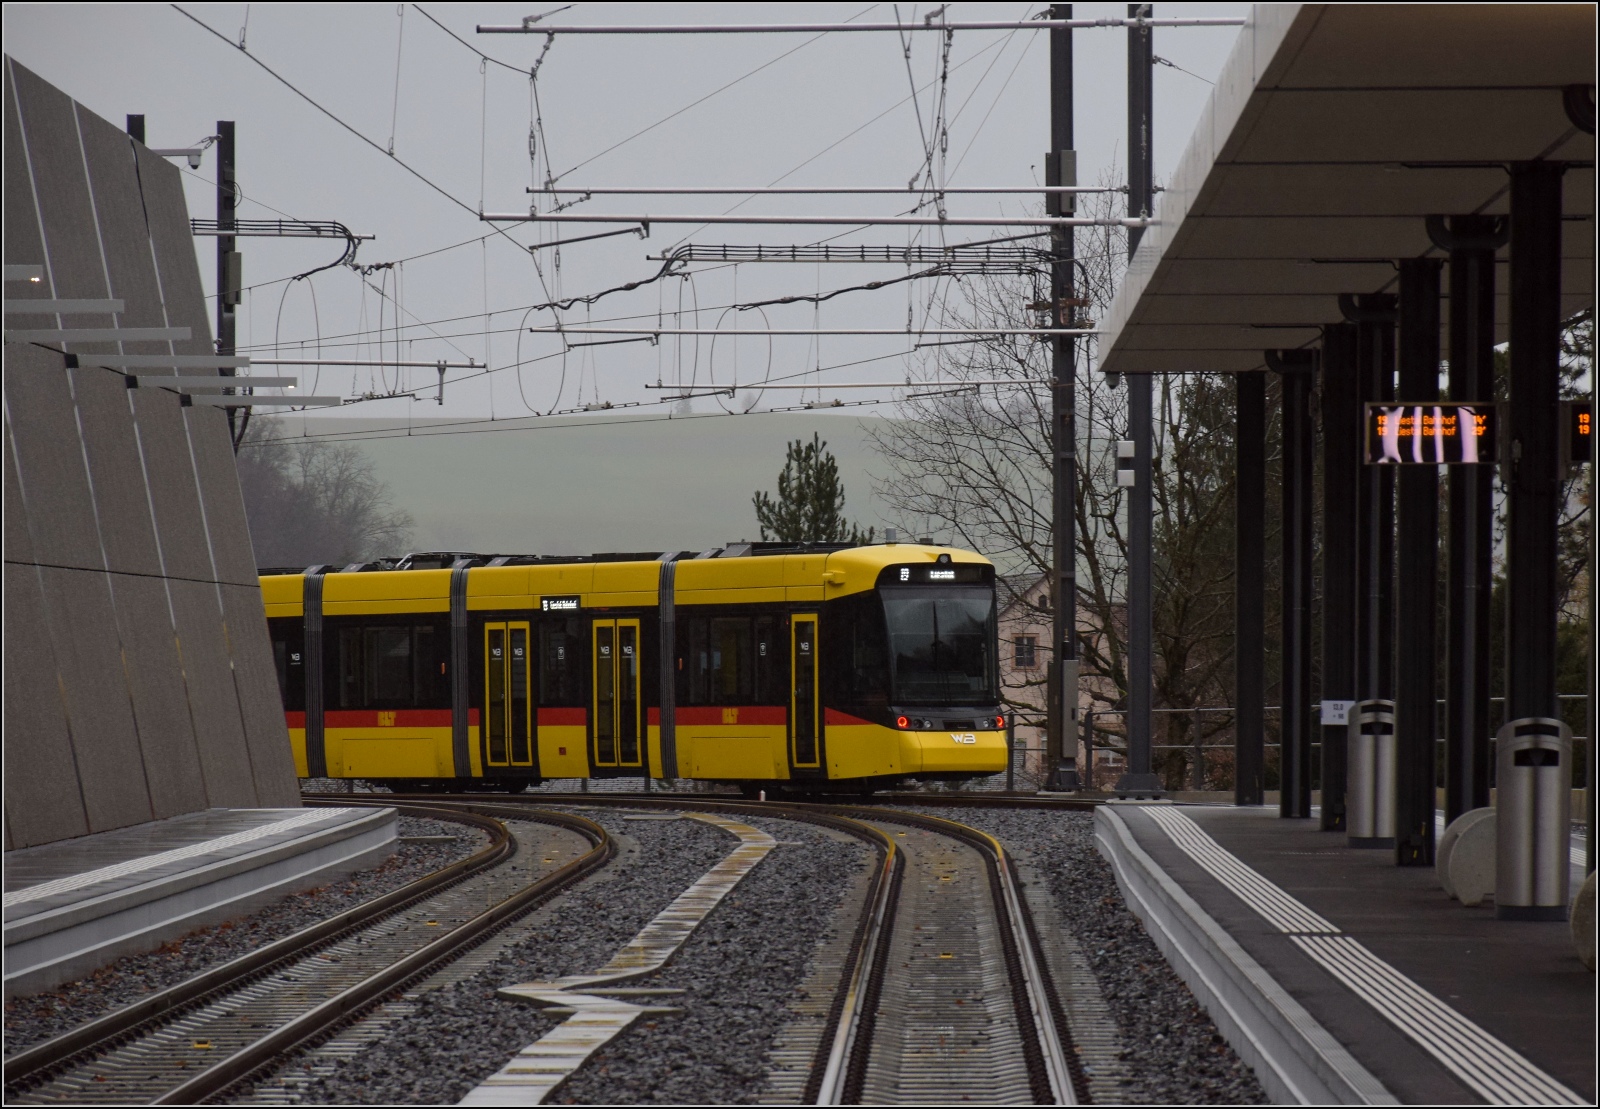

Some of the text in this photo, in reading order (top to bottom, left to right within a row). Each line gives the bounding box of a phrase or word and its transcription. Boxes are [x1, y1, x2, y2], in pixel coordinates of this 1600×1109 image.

[1377, 415, 1388, 425] 19
[1578, 413, 1590, 424] 19
[1377, 426, 1388, 436] 19
[1578, 424, 1590, 435] 19
[950, 733, 976, 744] WB
